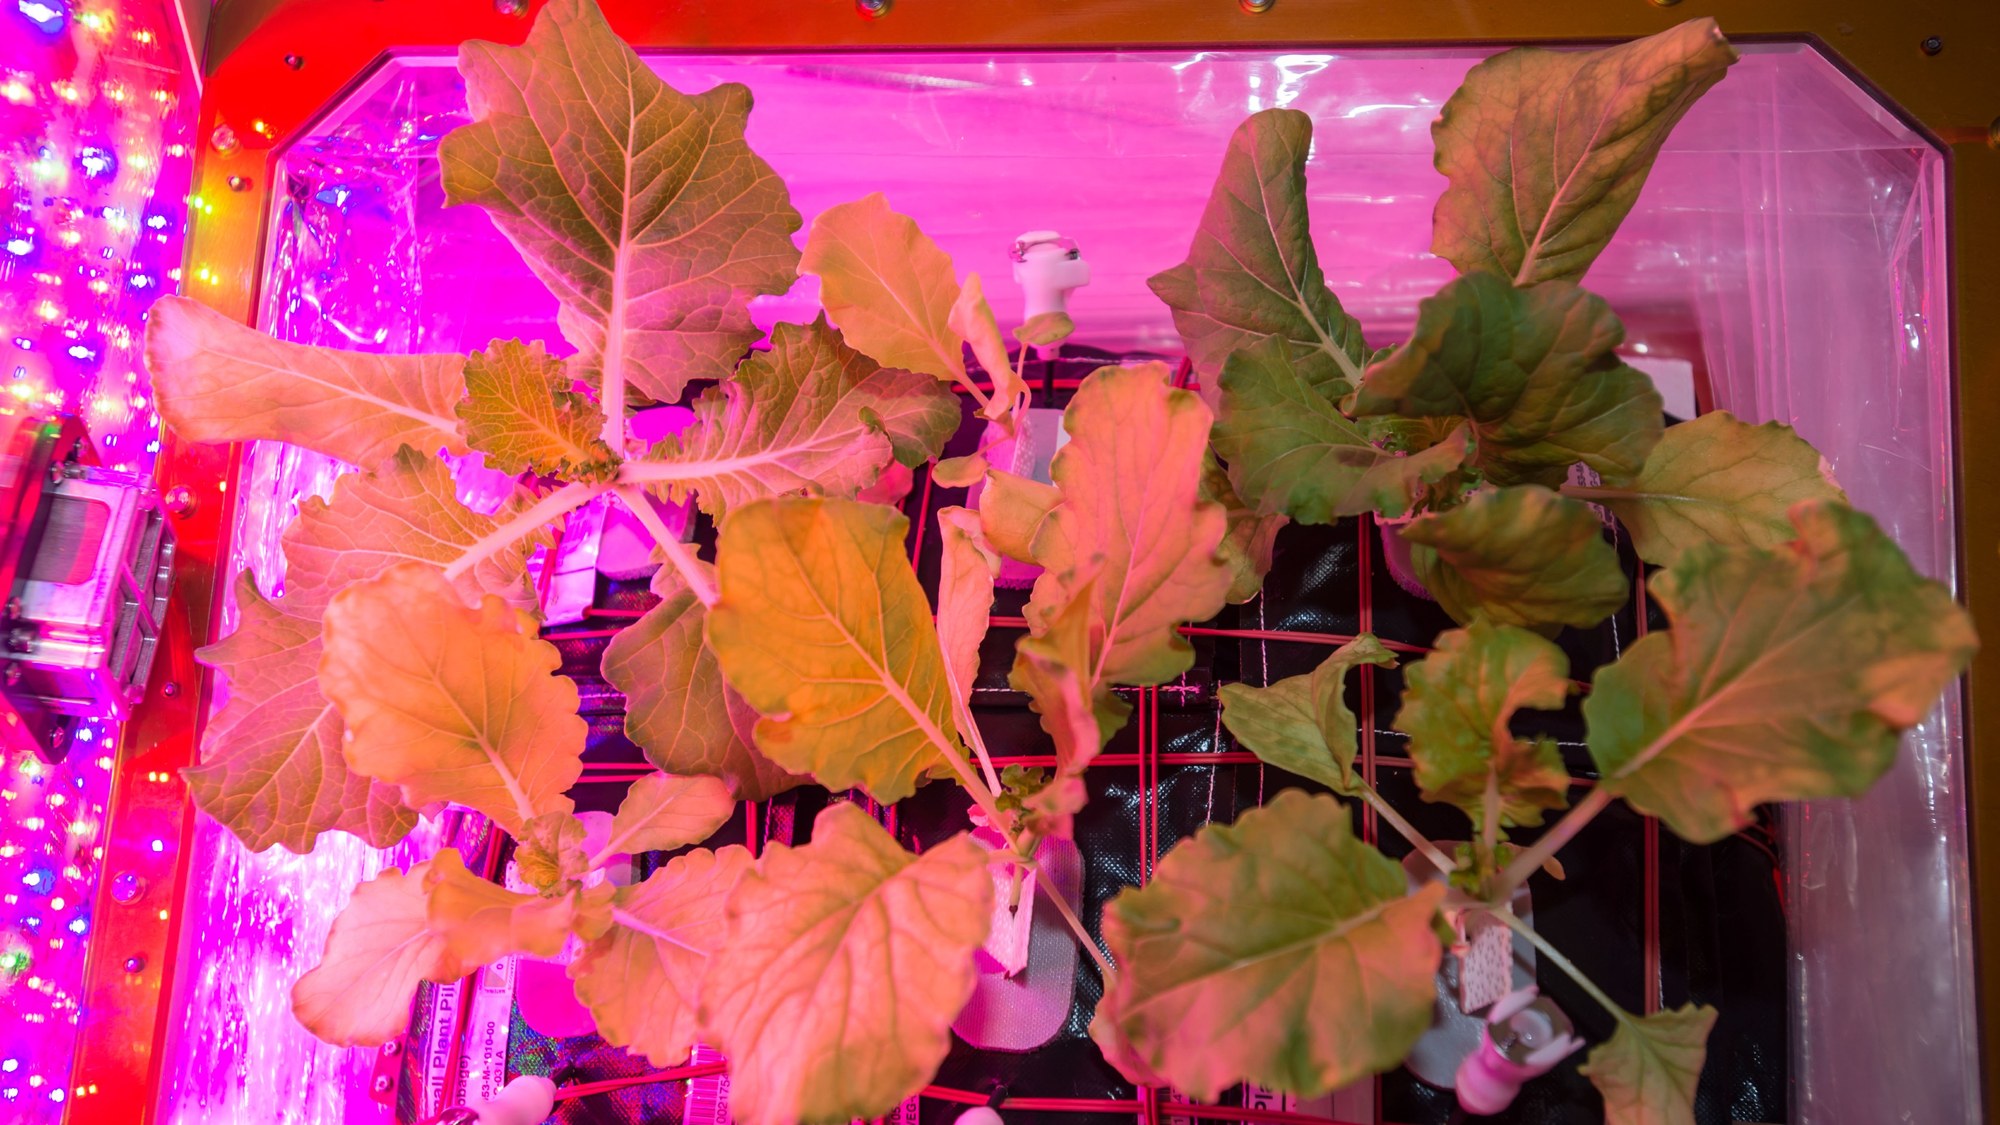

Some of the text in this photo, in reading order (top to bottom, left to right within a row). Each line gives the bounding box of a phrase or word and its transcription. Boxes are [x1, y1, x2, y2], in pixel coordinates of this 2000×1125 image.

[440, 982, 456, 1012] Pil
[433, 1017, 452, 1069] Plant
[481, 1021, 496, 1100] 53-M-1010-00
